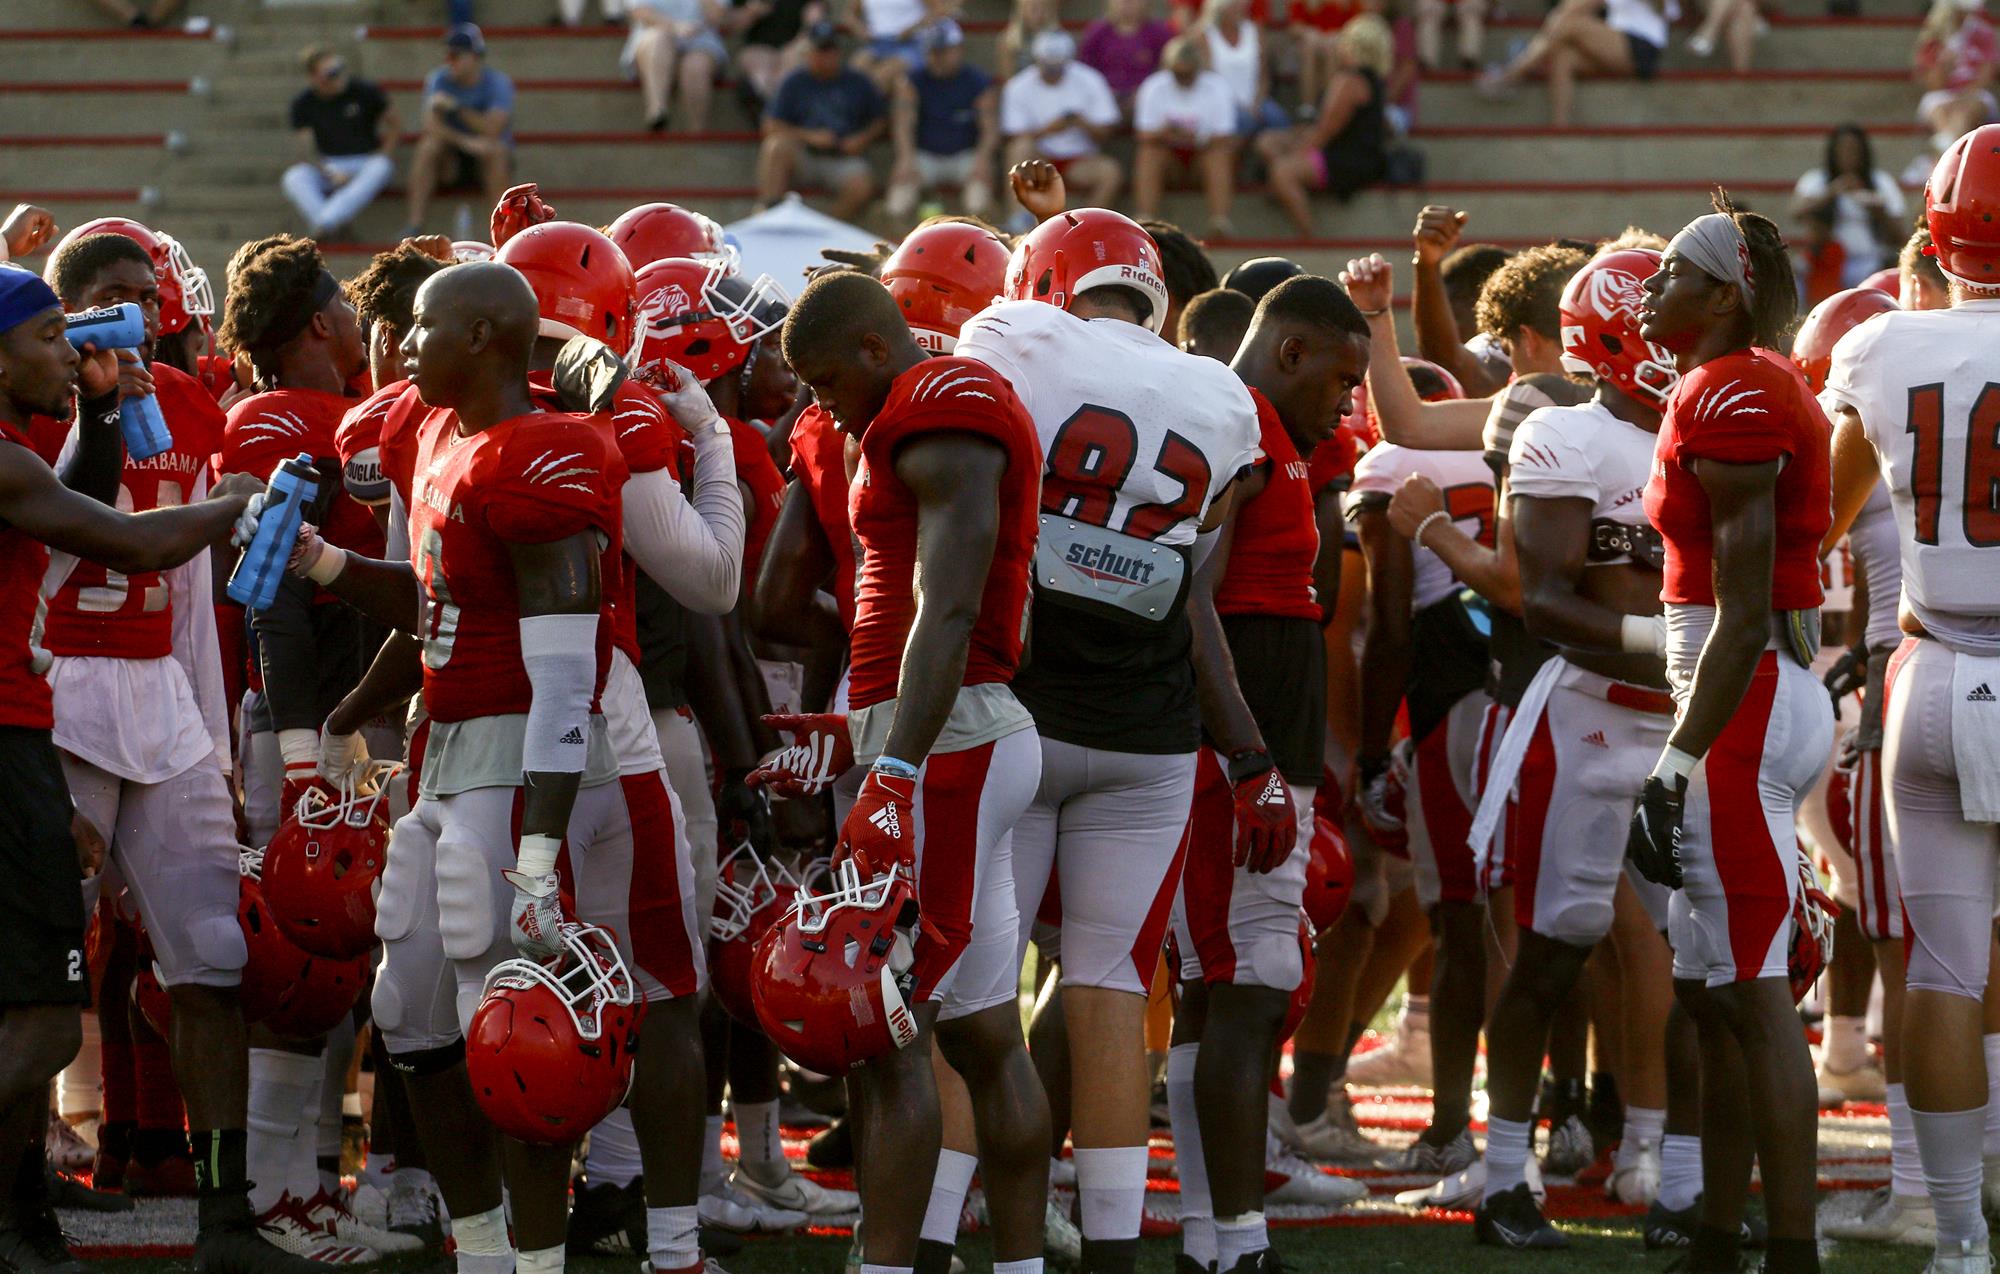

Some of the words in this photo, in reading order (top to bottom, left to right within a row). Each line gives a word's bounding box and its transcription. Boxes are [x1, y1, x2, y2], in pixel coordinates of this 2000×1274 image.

[346, 461, 384, 482] OUGLAS
[1040, 403, 1212, 542] 82
[1065, 543, 1154, 585] schutt
[1256, 773, 1277, 806] adidas
[887, 801, 901, 839] adidas
[527, 902, 542, 942] adidas
